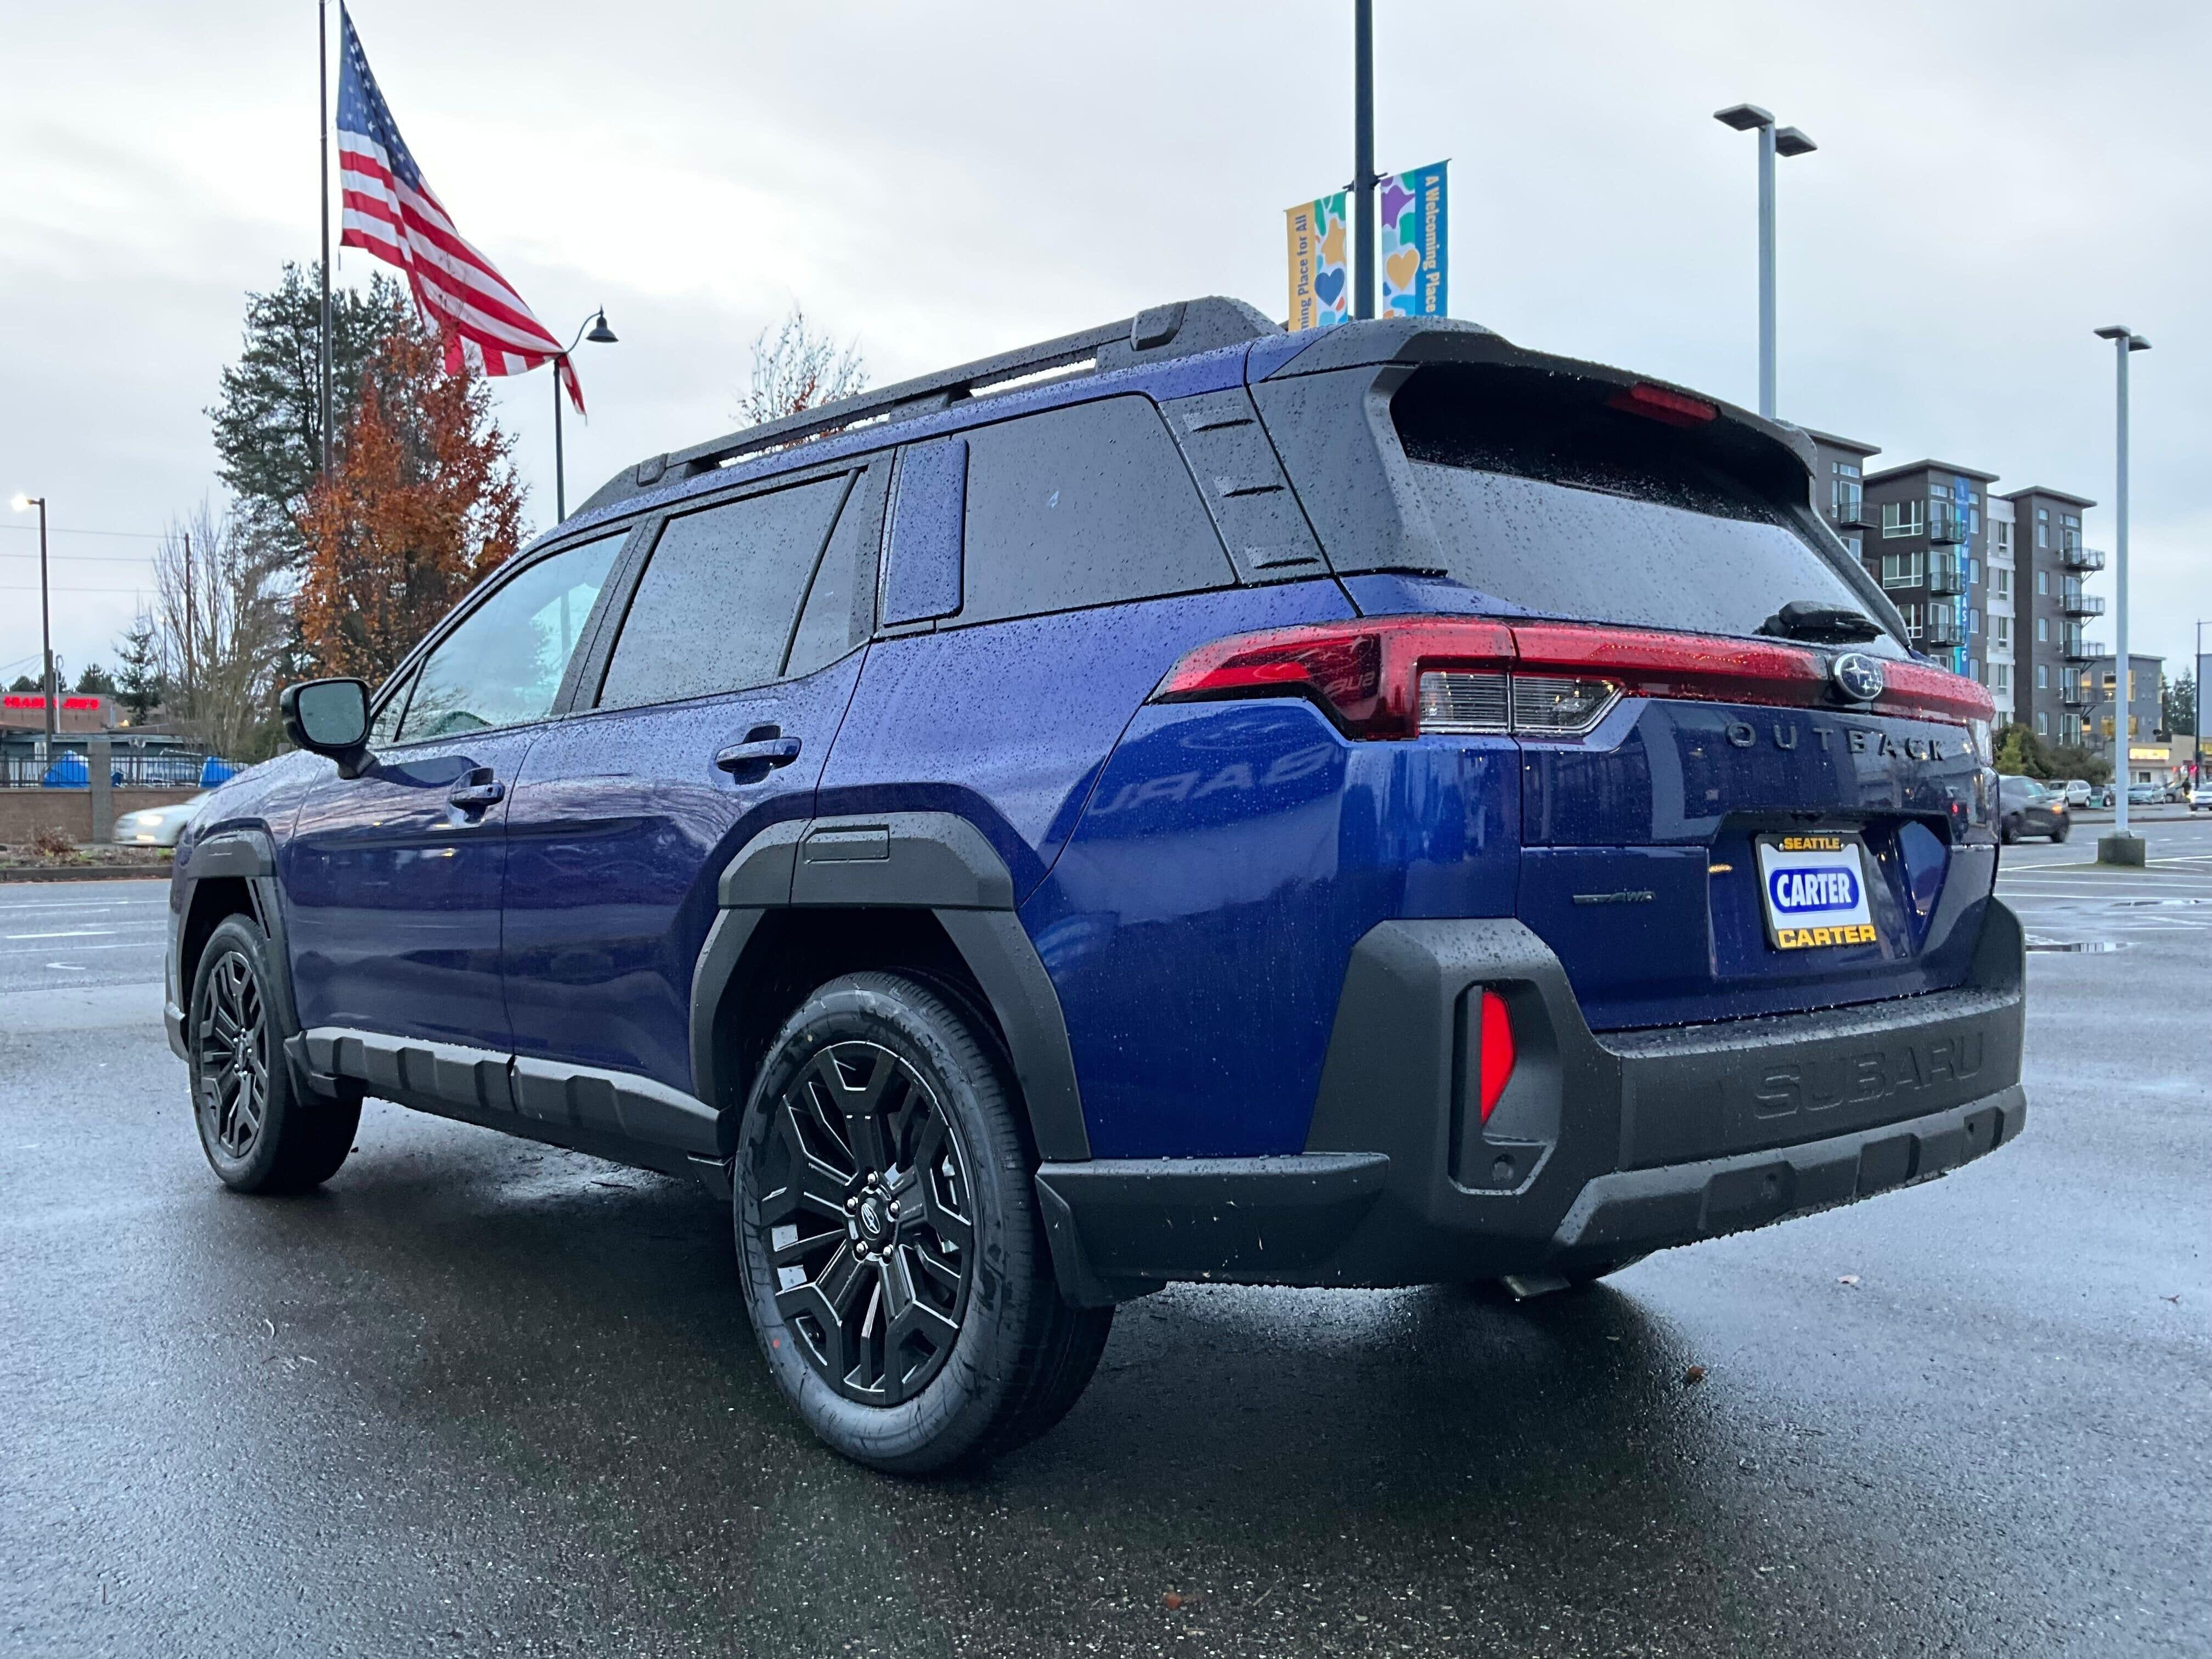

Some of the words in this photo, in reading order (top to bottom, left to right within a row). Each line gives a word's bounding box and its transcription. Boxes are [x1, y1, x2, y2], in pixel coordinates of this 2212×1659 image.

[1425, 176, 1439, 187] A
[1295, 214, 1307, 232] All
[1423, 187, 1440, 271] Welcoming
[1297, 236, 1308, 256] for
[1297, 258, 1308, 296] Place
[1425, 272, 1440, 313] Place
[1726, 721, 1943, 760] OUTBACK
[1784, 837, 1839, 850] SEATTLE
[1777, 873, 1852, 907] CARTER
[1778, 924, 1877, 948] CARTER
[1754, 1032, 1983, 1120] SUBARU
